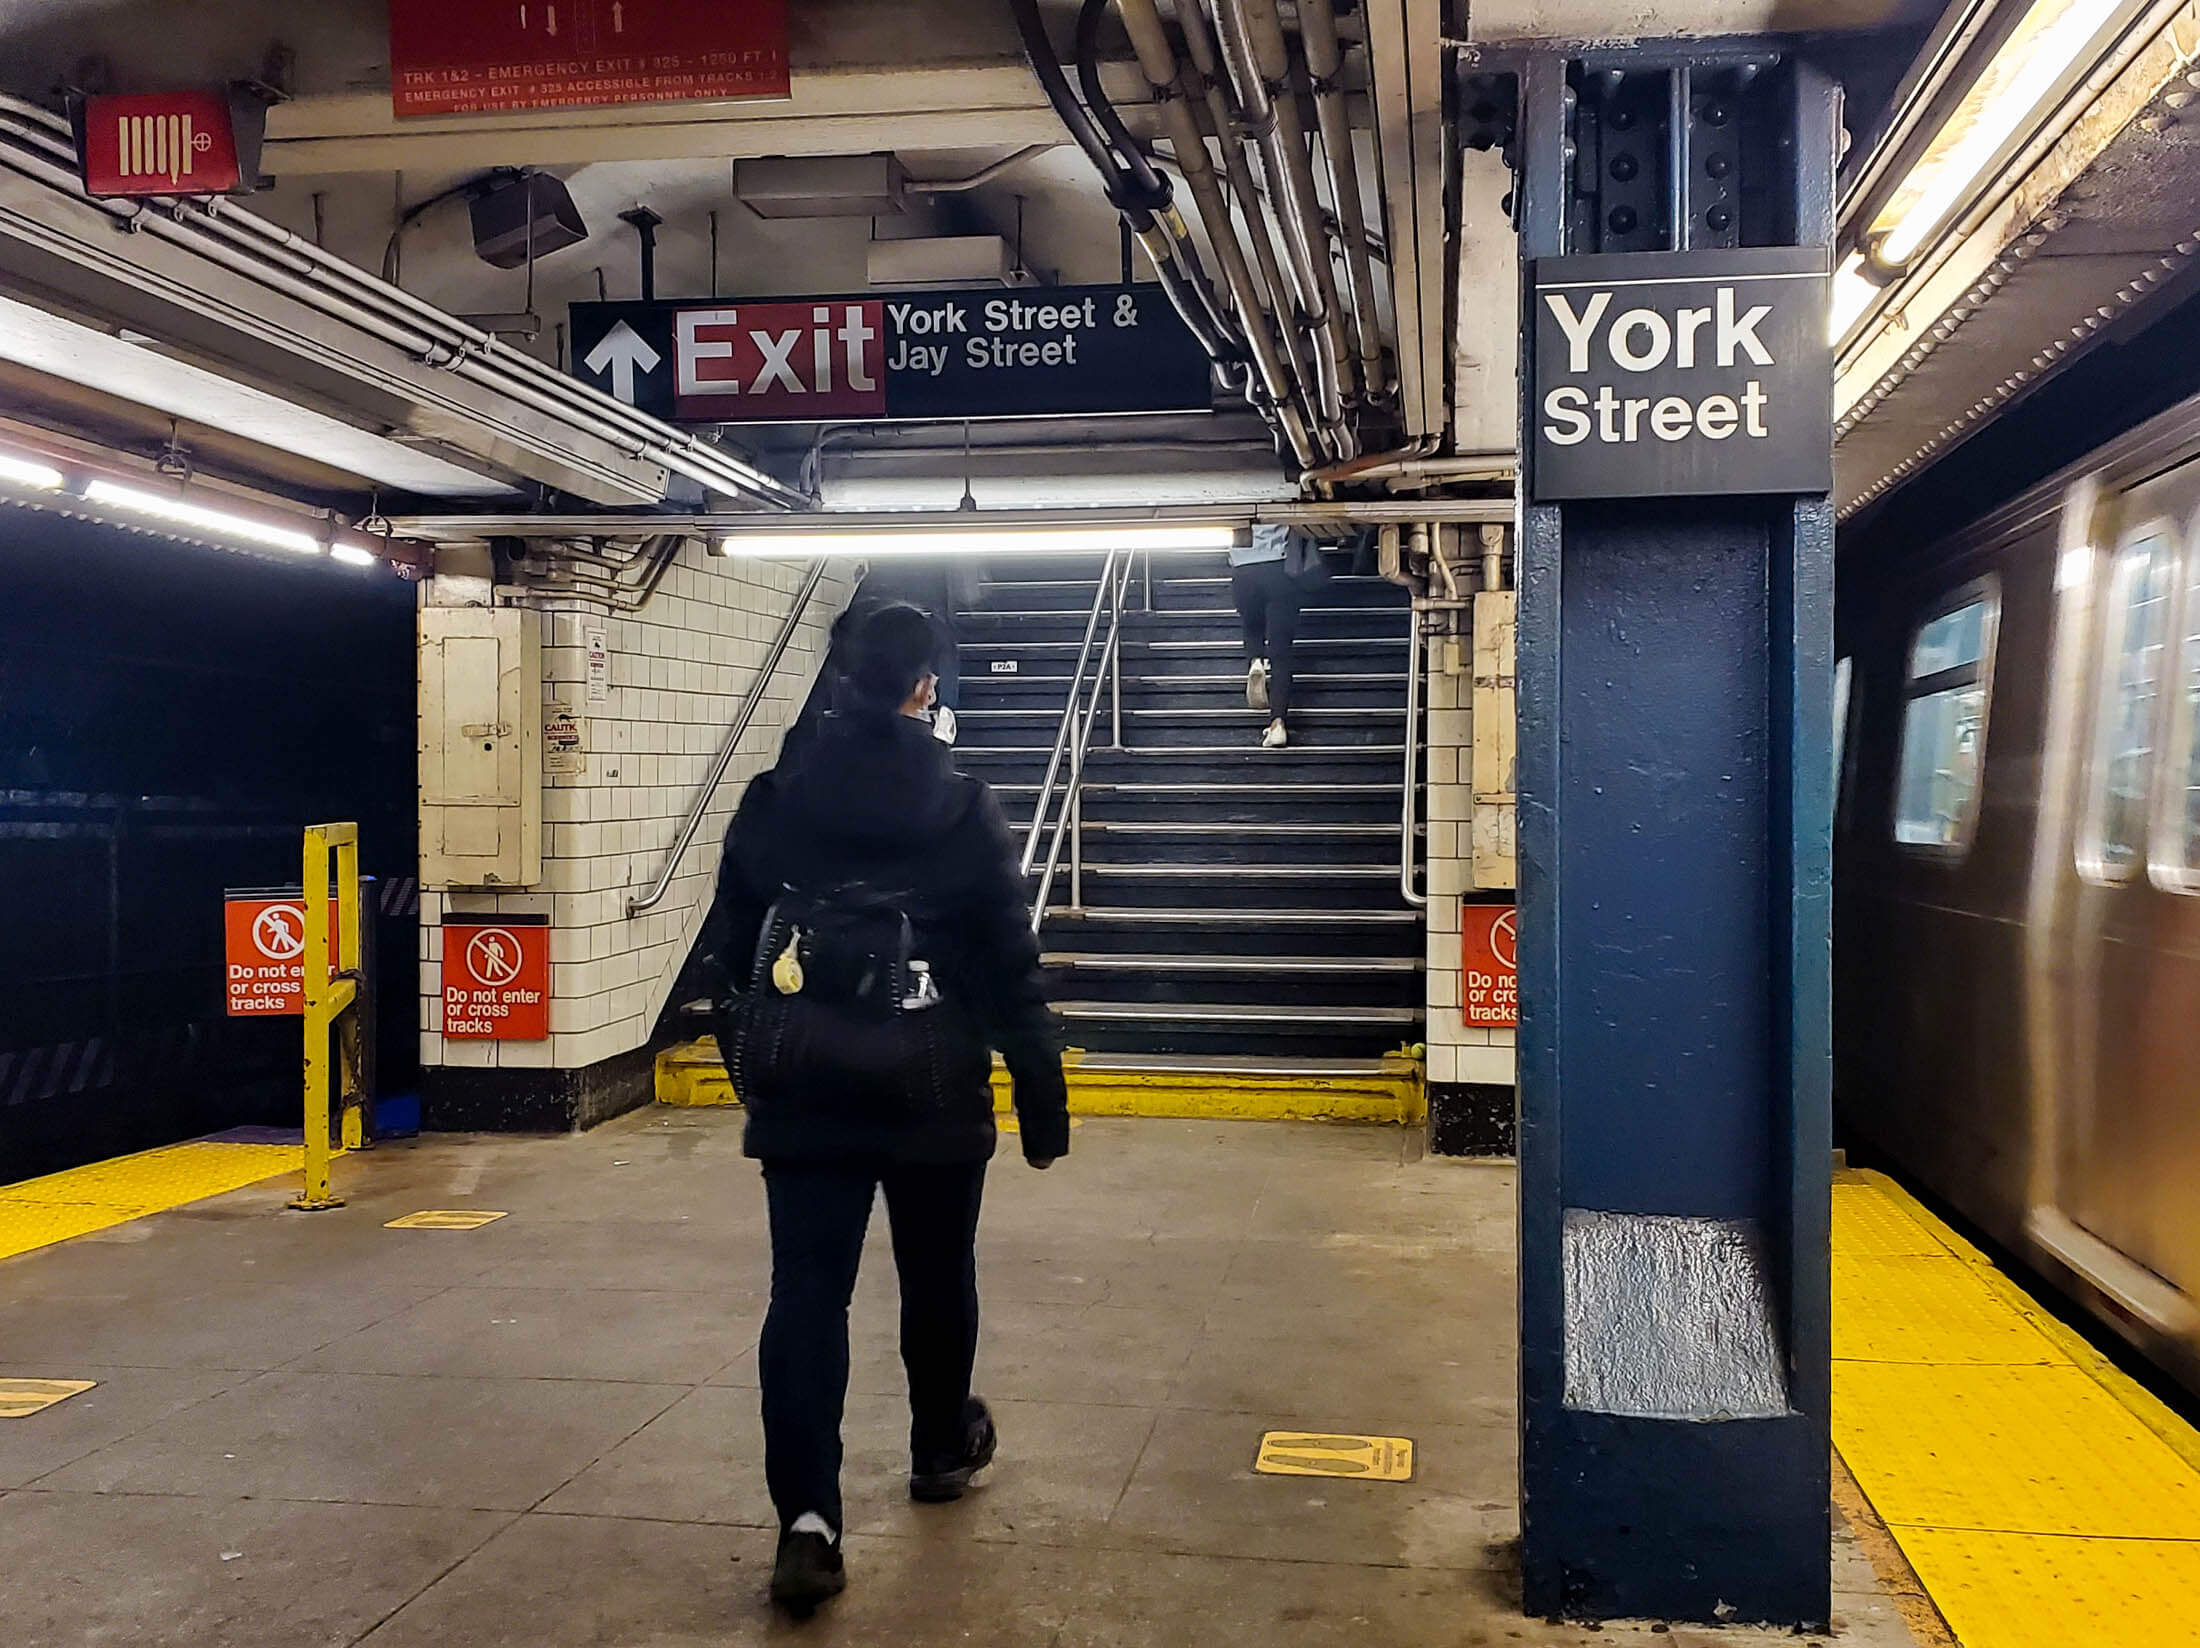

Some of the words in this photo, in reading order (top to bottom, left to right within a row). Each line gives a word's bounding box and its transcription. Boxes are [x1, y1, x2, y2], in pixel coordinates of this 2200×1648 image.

[404, 71, 434, 85] TRK
[441, 69, 469, 82] 1&2
[488, 61, 589, 80] EMERGENCY
[596, 58, 630, 73] EXIT
[405, 87, 485, 102] EMERGENCY
[491, 85, 520, 97] EXIT
[567, 77, 649, 92] ACCESSIBLE
[655, 75, 694, 87] FROM
[701, 71, 752, 84] TRACKS
[888, 303, 968, 335] York
[984, 298, 1096, 332] Street
[1113, 294, 1138, 327] &
[1544, 287, 1776, 373] York
[677, 305, 876, 396] Exit
[888, 340, 948, 377] Jay
[966, 335, 1077, 368] Street
[1543, 380, 1768, 446] Street
[229, 964, 254, 979] Do
[258, 964, 287, 978] not
[1468, 971, 1492, 988] Do
[1498, 974, 1517, 988] no
[230, 982, 249, 995] or
[253, 982, 301, 994] cross
[446, 986, 468, 1003] Do
[473, 987, 497, 1003] not
[502, 988, 540, 1004] enter
[1469, 989, 1487, 1003] or
[1492, 989, 1517, 1003] cro
[231, 995, 285, 1011] tracks
[446, 1003, 463, 1017] or
[468, 1004, 509, 1017] cross
[447, 1017, 493, 1033] tracks
